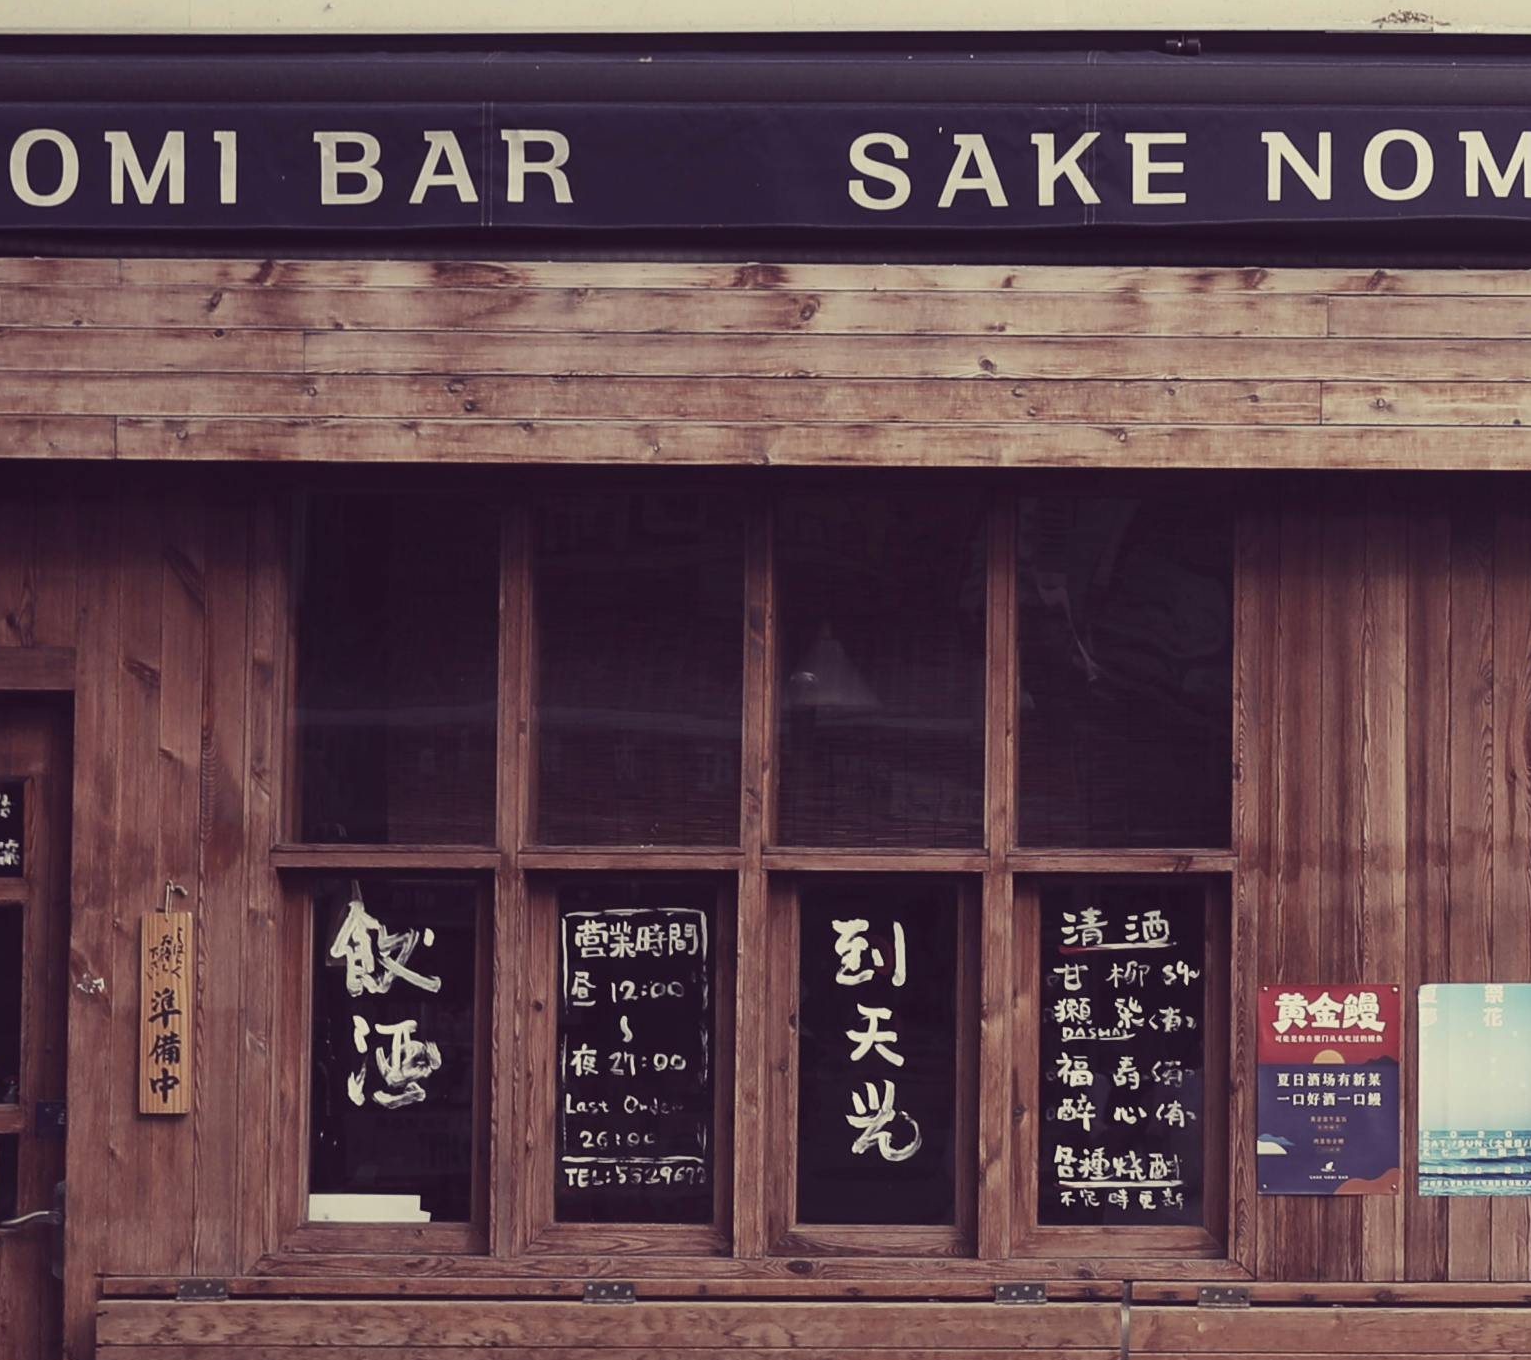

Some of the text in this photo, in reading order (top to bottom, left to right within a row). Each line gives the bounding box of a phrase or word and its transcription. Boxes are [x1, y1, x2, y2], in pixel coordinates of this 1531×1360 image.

[313, 128, 575, 204] BAR
[848, 130, 1186, 210] SAKE
[1061, 907, 1171, 946] 清酒
[611, 979, 685, 1003] 12:00
[148, 988, 182, 1104] 準備中
[570, 1043, 599, 1077] 夜
[565, 1093, 610, 1114] Last
